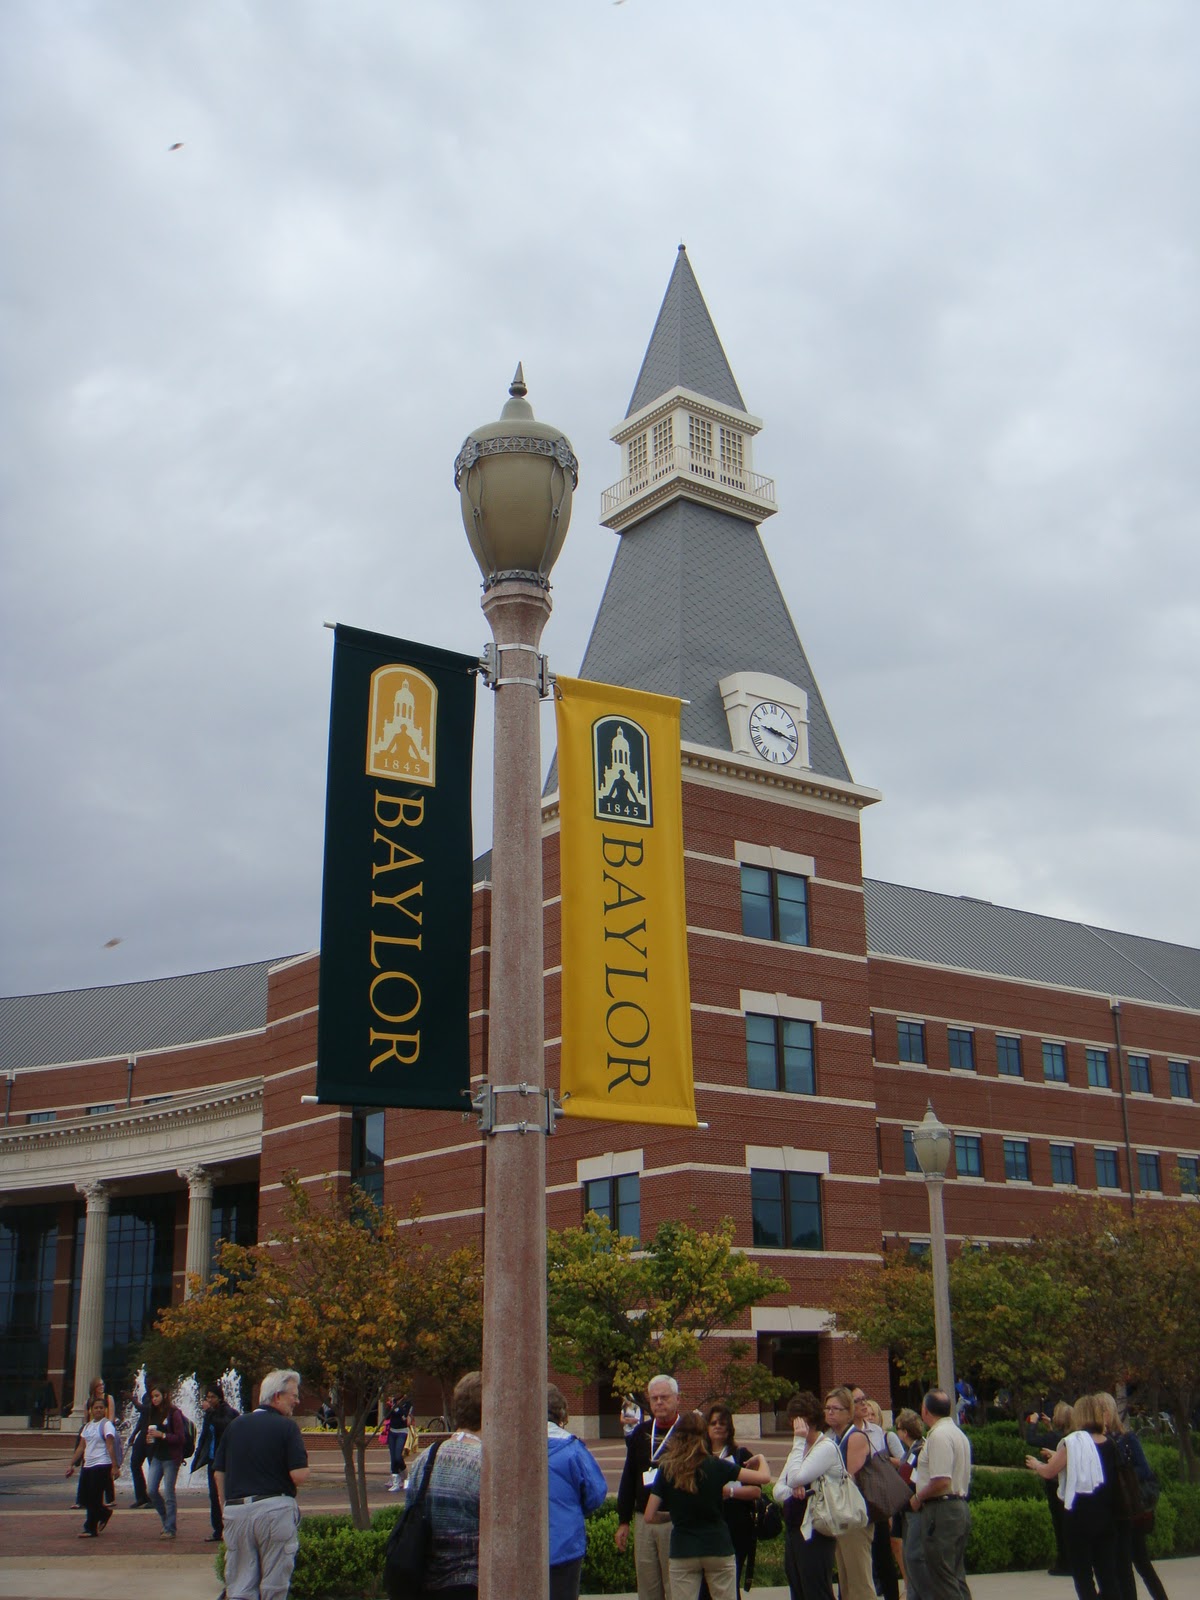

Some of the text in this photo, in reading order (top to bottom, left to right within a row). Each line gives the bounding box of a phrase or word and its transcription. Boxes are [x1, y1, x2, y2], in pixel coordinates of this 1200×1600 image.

[384, 758, 421, 774] 1845
[606, 802, 639, 816] 1845
[369, 789, 425, 1072] BAYLOR
[601, 833, 652, 1094] BAYLOR
[84, 1122, 230, 1161] BUILDING
